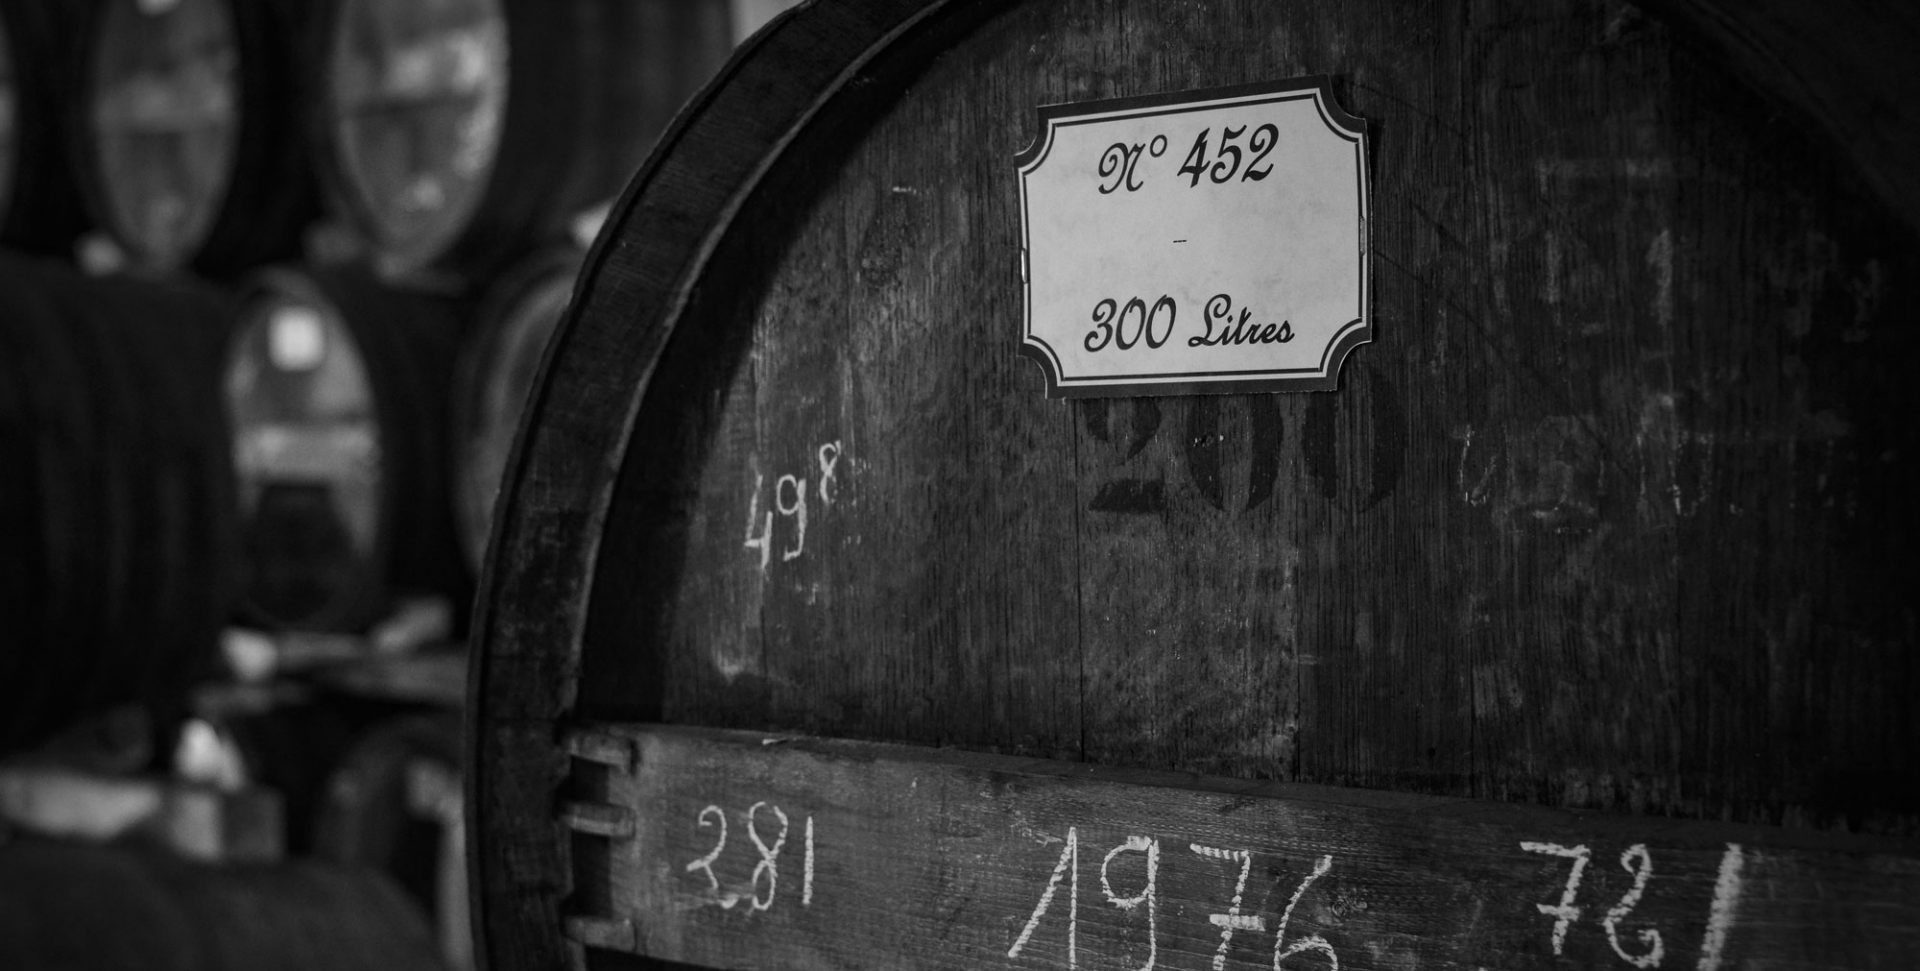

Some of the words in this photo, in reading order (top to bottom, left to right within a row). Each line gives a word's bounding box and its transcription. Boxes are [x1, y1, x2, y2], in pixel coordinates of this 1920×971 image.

[1177, 123, 1279, 188] 452
[1084, 294, 1177, 352] 300
[1188, 293, 1295, 347] Litres
[1083, 374, 1404, 513] 200
[686, 801, 814, 911] 281
[1008, 827, 1339, 971] 1976
